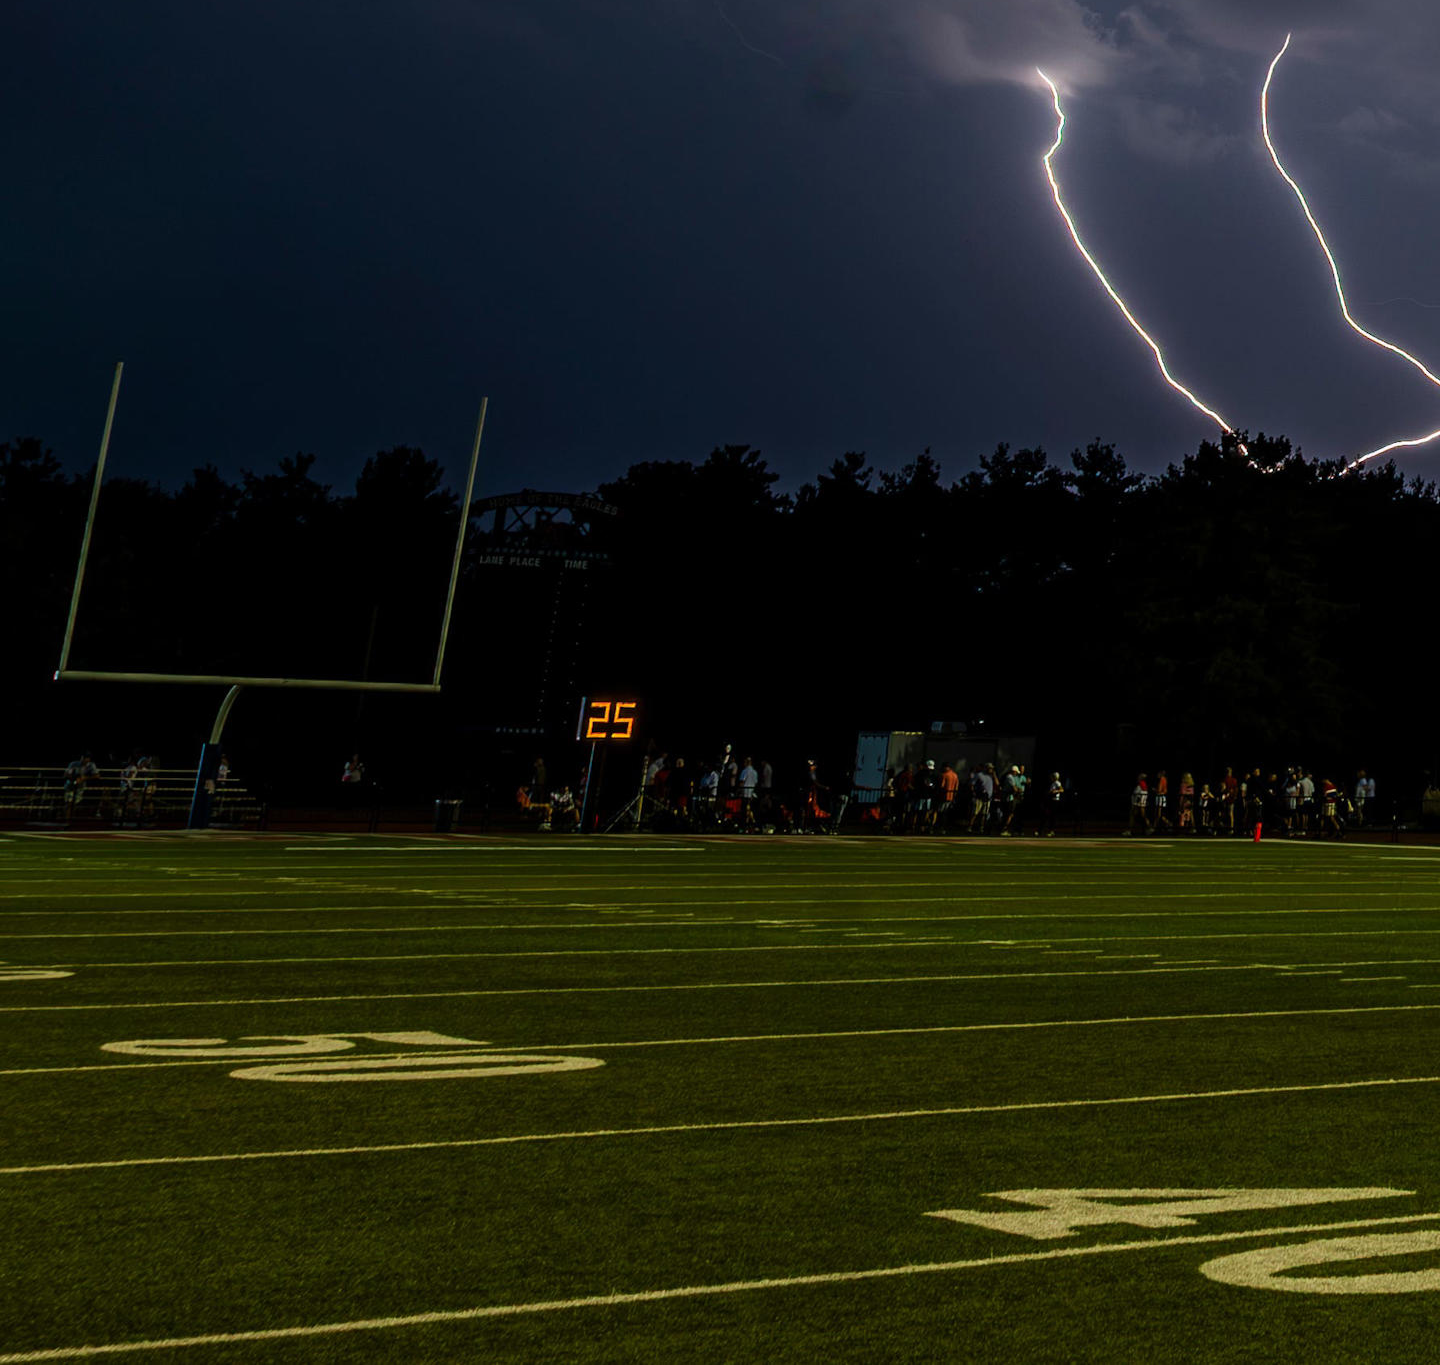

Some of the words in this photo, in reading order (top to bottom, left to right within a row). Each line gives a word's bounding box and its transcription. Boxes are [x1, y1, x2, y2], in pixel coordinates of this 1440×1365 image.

[480, 555, 505, 565] LANE
[509, 556, 542, 568] PLACE
[564, 559, 589, 570] TIME
[586, 702, 636, 738] 25
